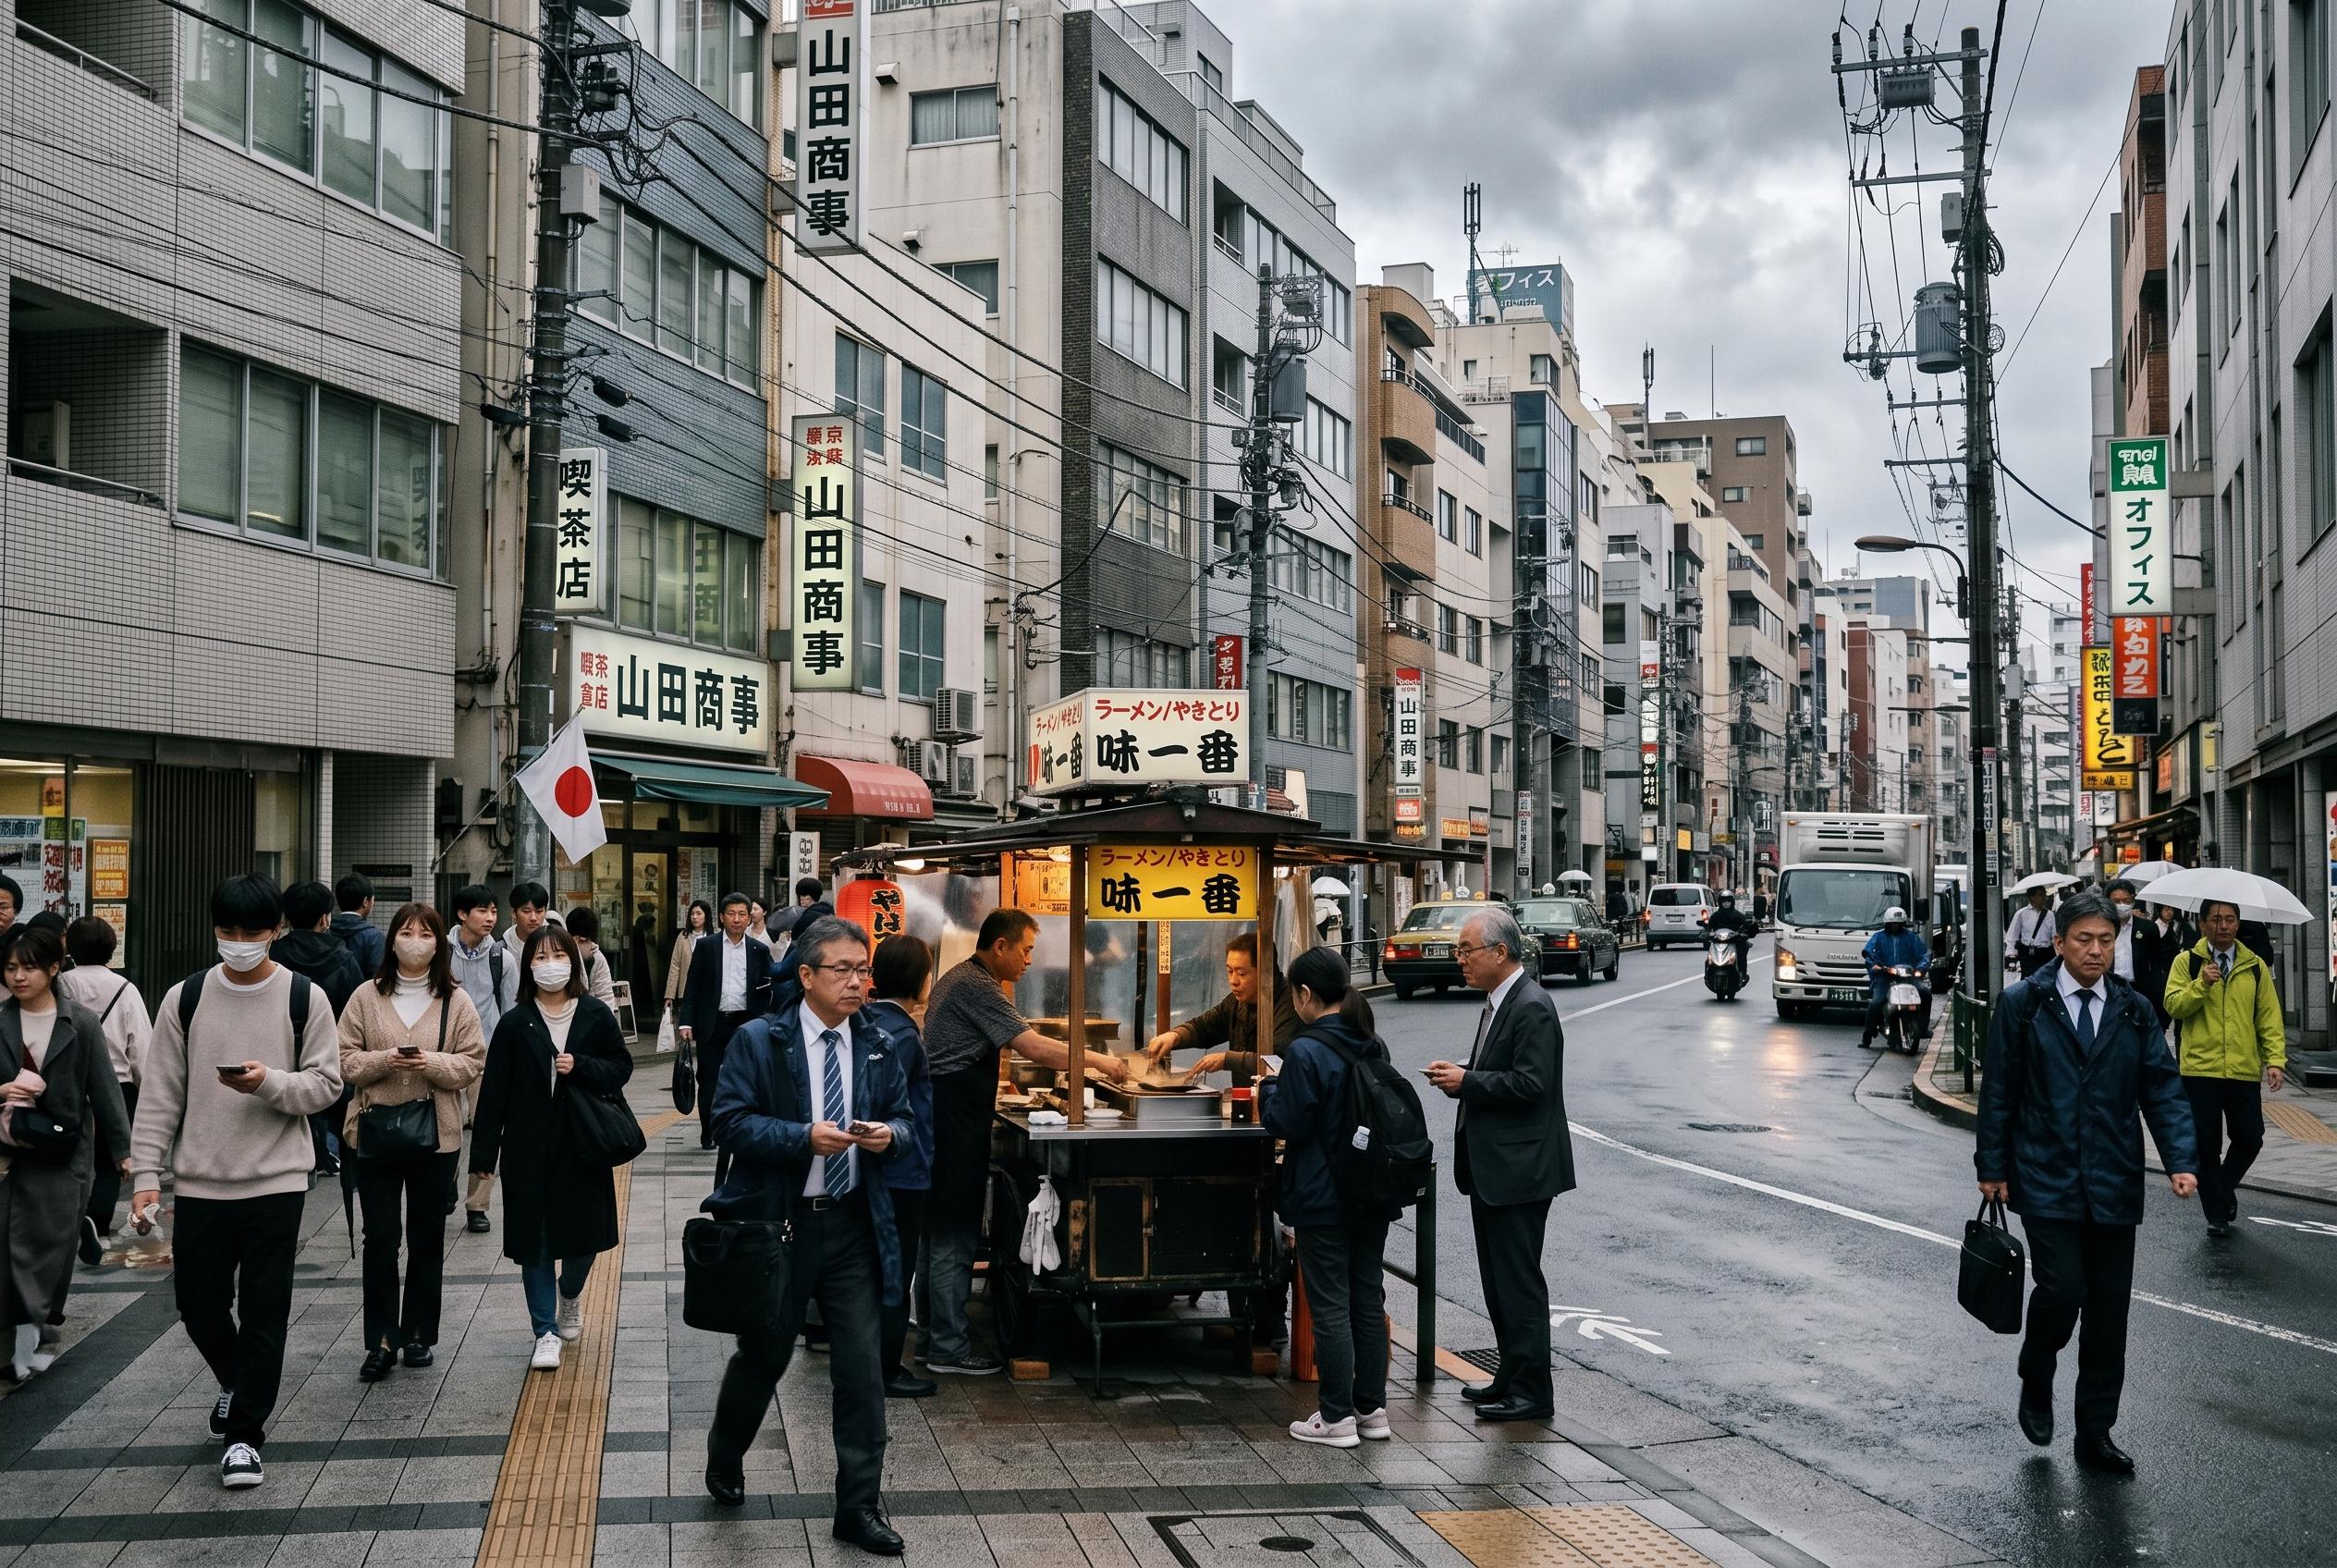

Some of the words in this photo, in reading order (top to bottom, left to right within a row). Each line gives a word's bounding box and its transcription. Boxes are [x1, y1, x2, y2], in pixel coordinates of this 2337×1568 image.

[806, 30, 850, 237] 山田商事
[557, 459, 592, 599] 喫茶店
[2125, 496, 2155, 606] オフィス
[802, 476, 845, 676] 山田商事
[618, 655, 760, 735] 山田商事
[1095, 699, 1241, 722] ラーメン/やきとり
[1096, 729, 1240, 775] 味一番
[1400, 697, 1417, 778] 山田商事
[1100, 848, 1245, 868] ラーメン/やきとり
[1101, 872, 1242, 915] 味一番
